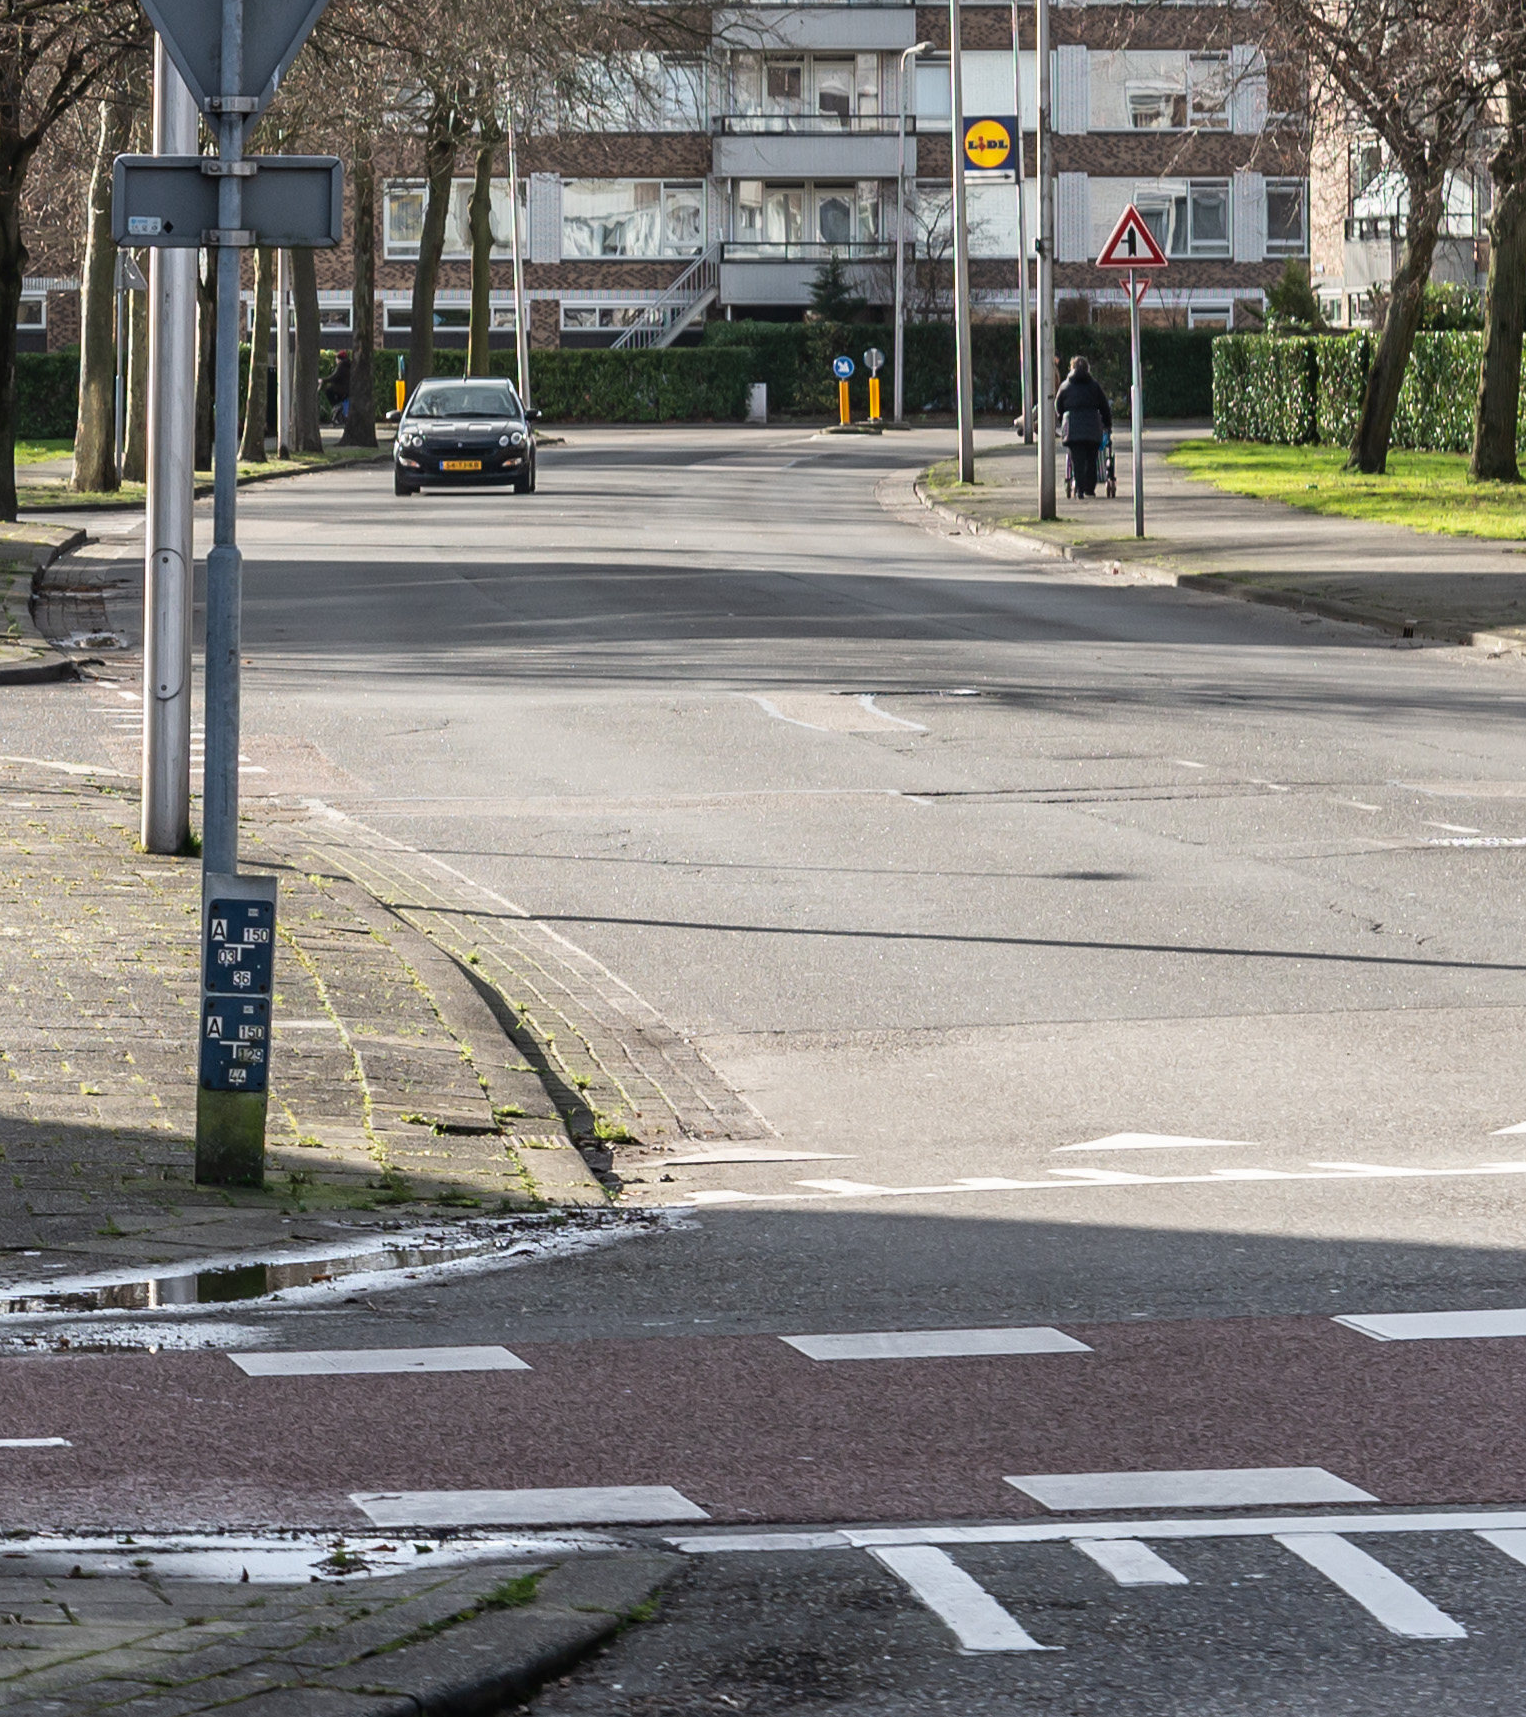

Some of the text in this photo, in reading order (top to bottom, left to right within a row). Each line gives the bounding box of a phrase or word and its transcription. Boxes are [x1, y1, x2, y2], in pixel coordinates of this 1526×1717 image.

[212, 919, 226, 940] A
[244, 928, 269, 942] 150
[218, 949, 235, 964] 03
[233, 971, 250, 985] 36
[207, 1017, 221, 1037] A
[240, 1025, 264, 1040] 150
[239, 1048, 263, 1061] 129
[229, 1068, 246, 1081] 44
